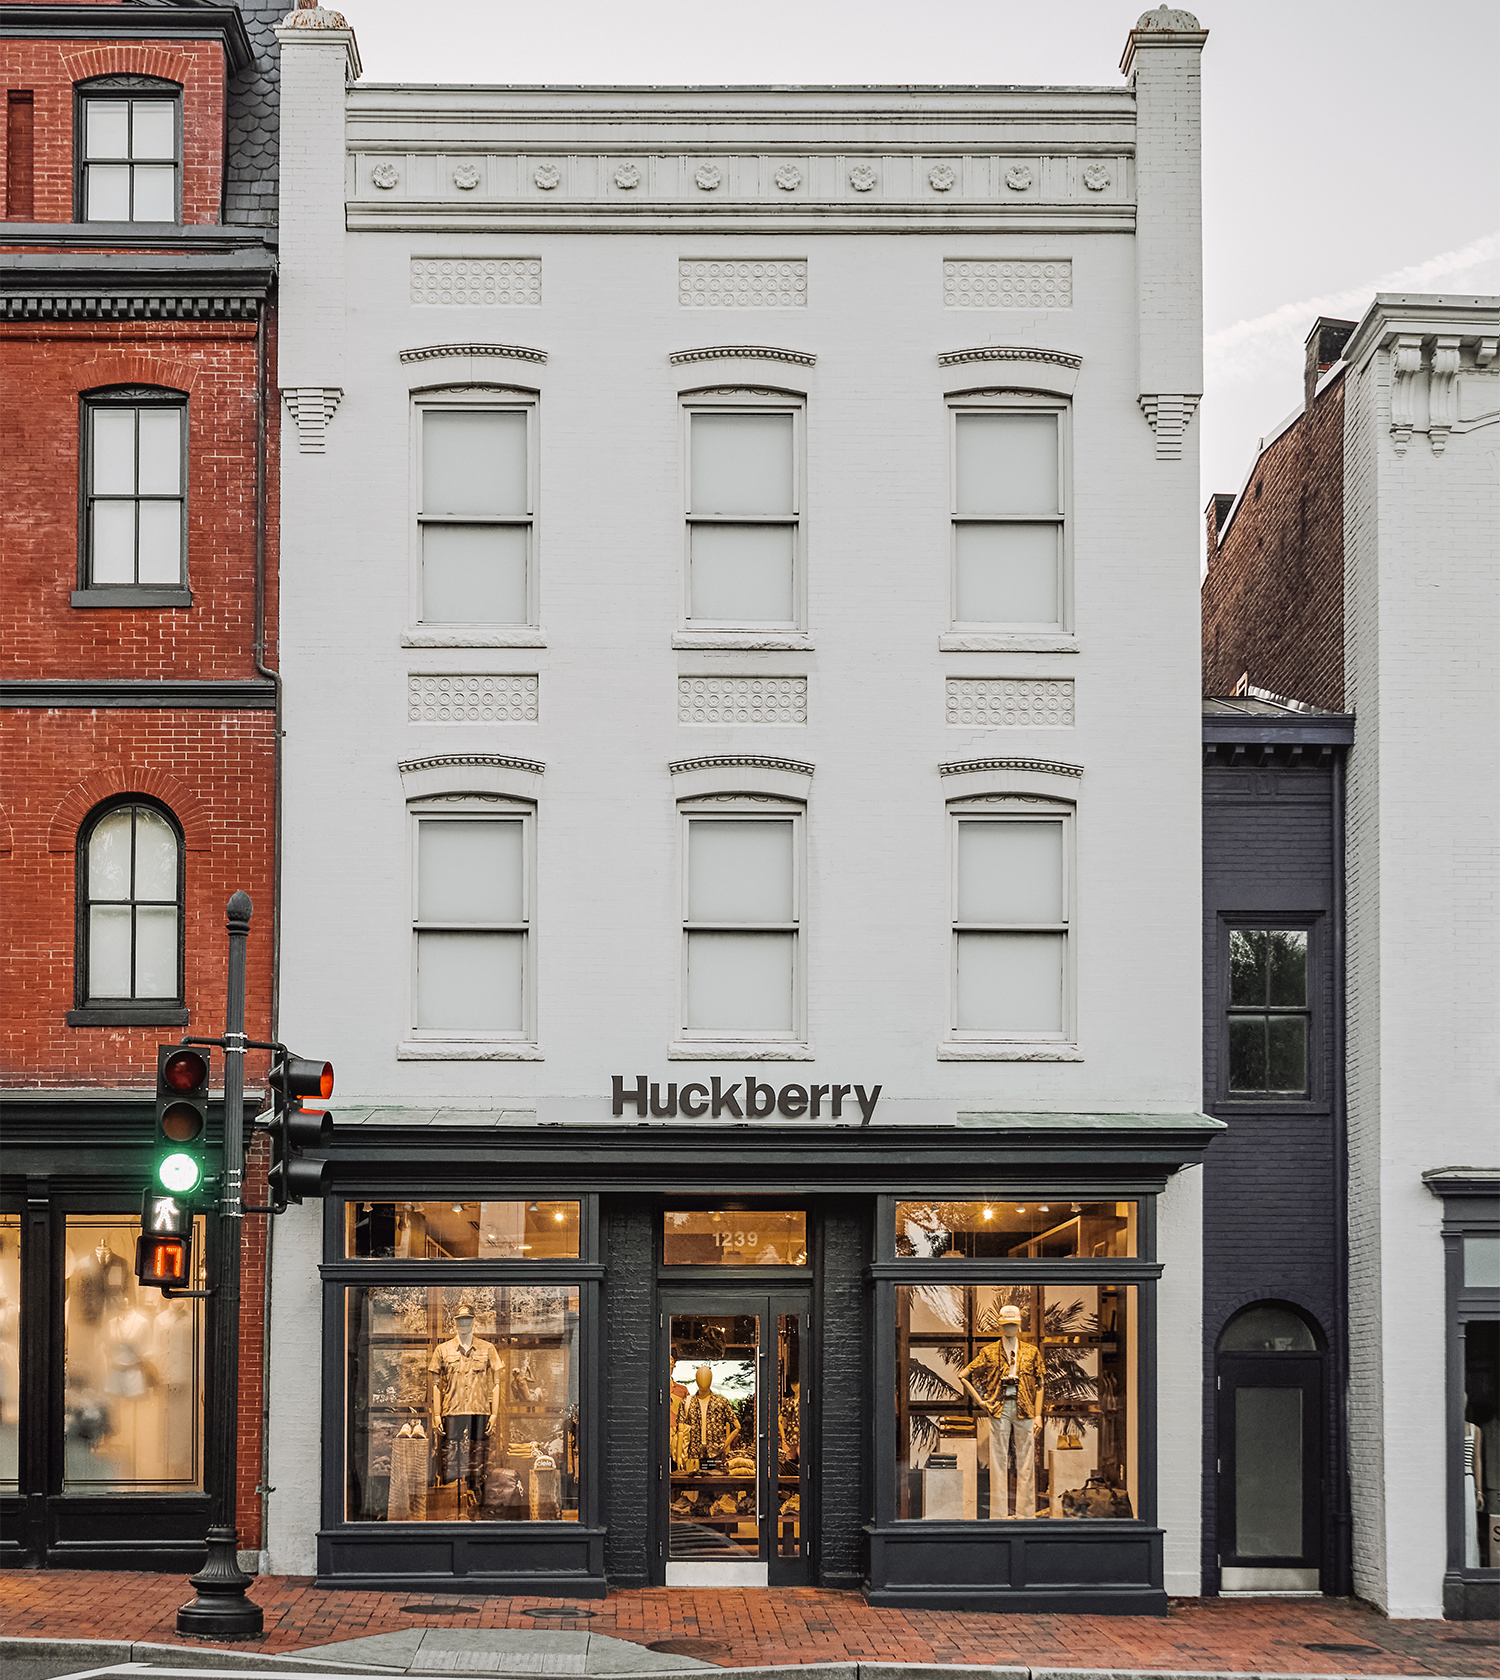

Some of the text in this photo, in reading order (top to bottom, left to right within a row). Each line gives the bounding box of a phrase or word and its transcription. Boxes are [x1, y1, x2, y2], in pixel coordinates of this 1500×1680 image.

[611, 1075, 882, 1126] Huckberry
[712, 1231, 758, 1247] 1239
[155, 1245, 182, 1278] 17
